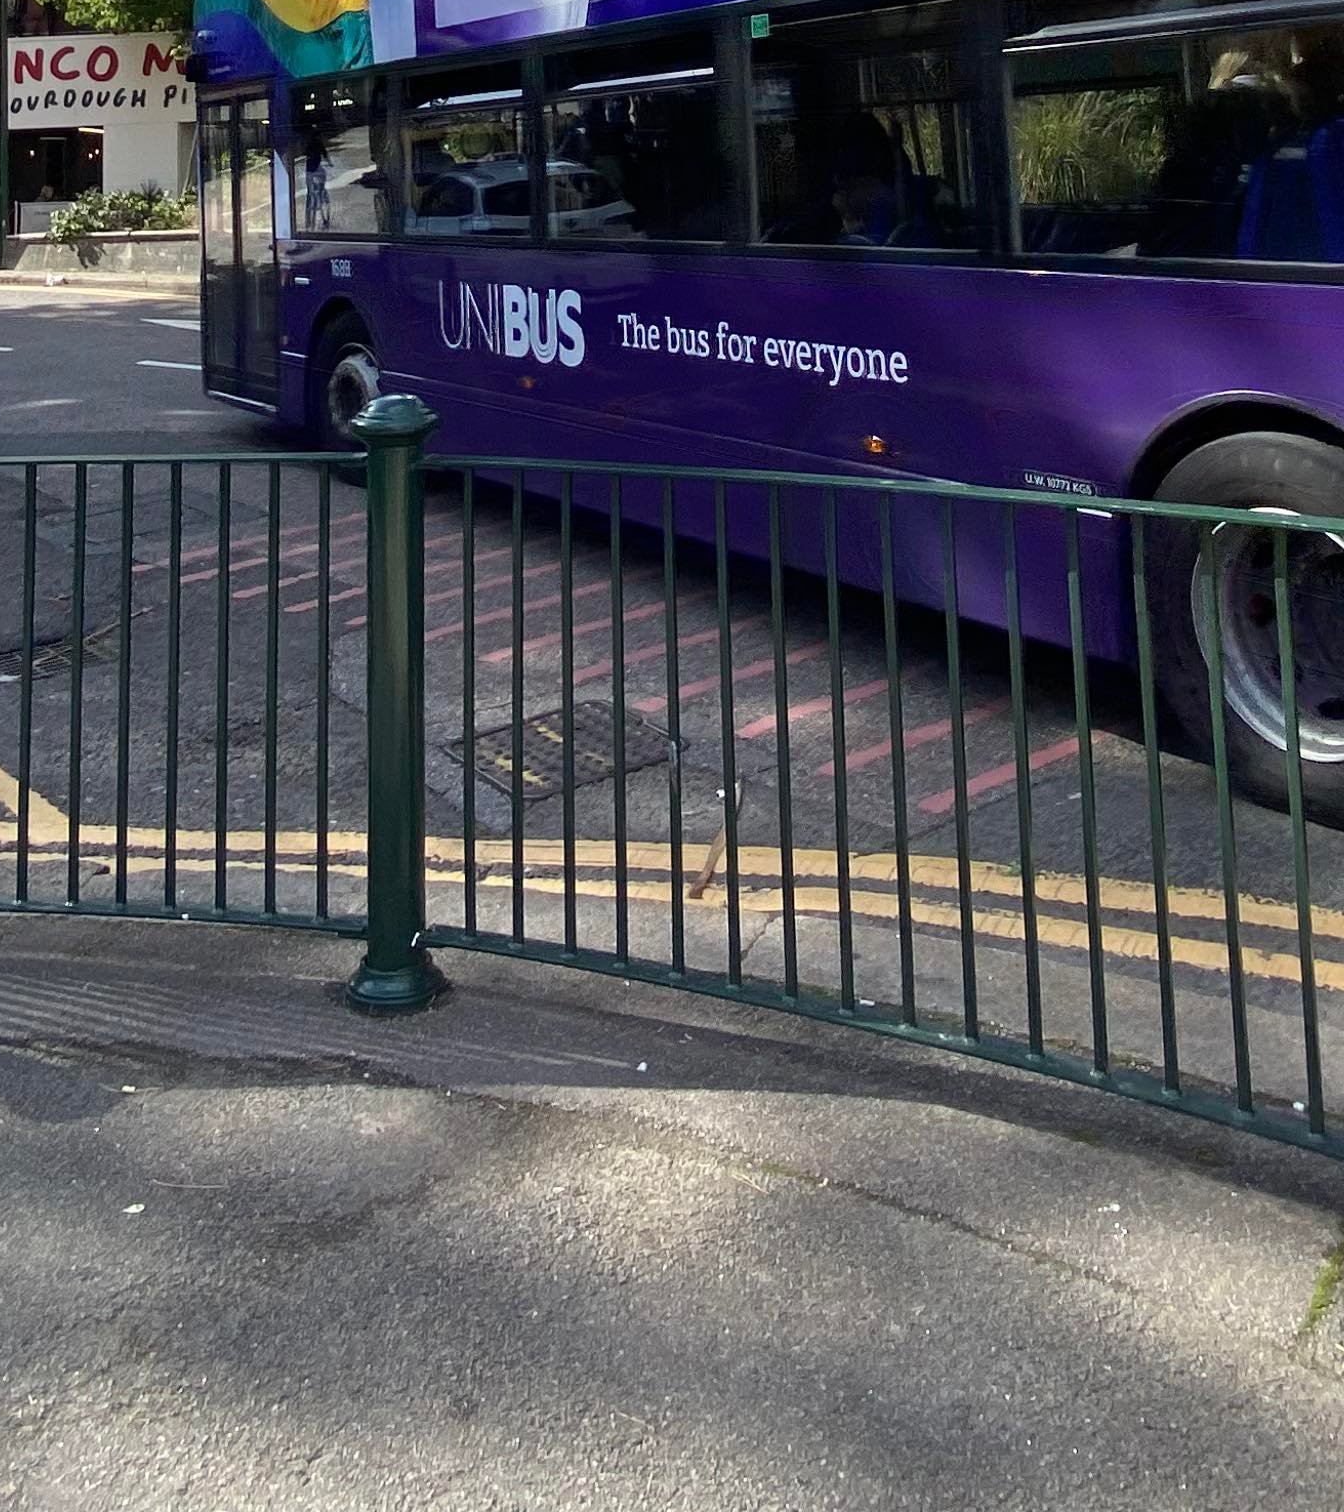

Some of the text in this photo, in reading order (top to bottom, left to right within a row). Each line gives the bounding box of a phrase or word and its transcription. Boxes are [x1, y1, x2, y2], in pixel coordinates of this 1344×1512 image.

[439, 280, 910, 386] UNIBUS The bus for everyone
